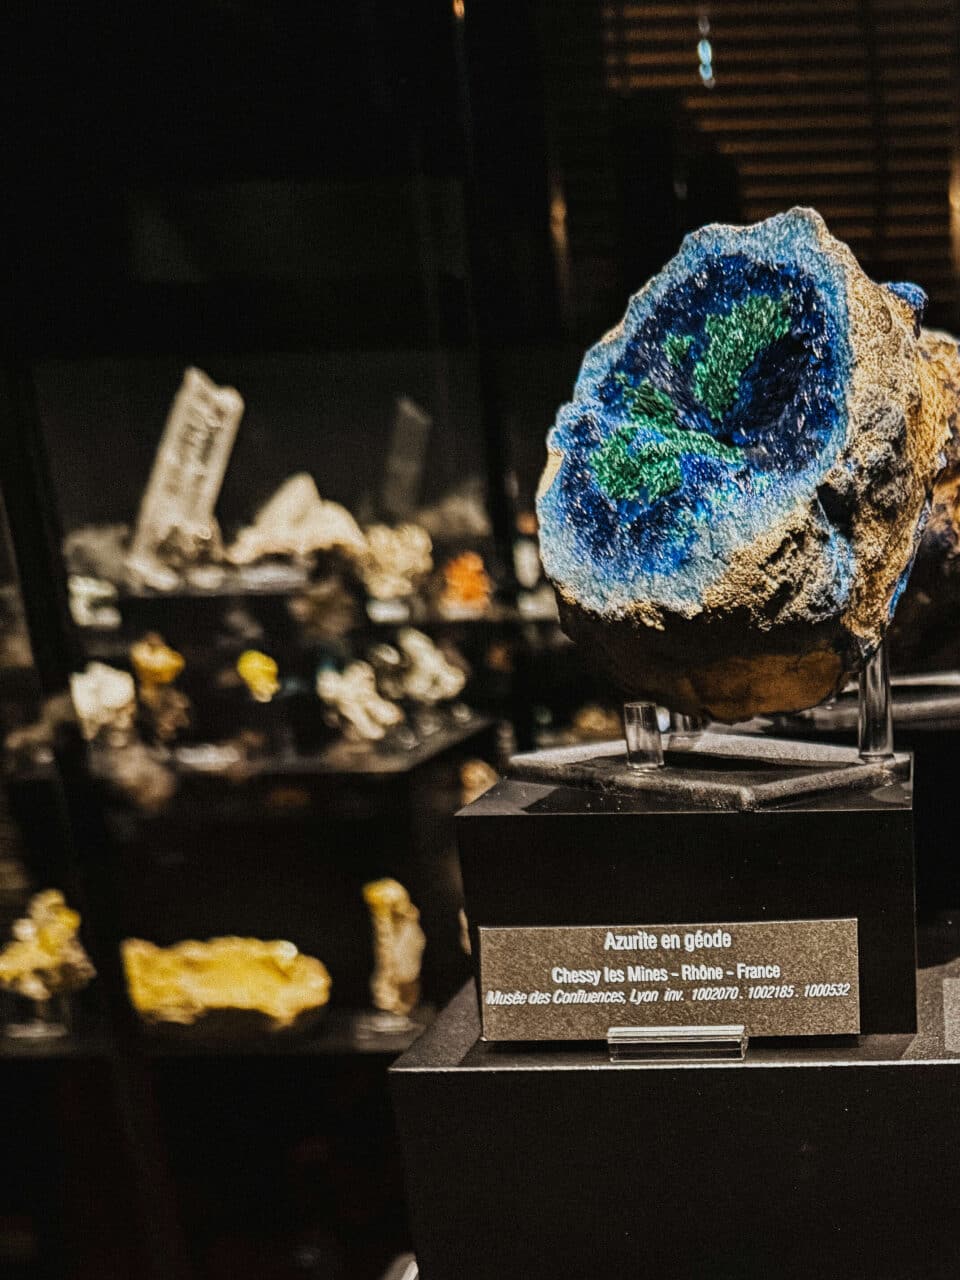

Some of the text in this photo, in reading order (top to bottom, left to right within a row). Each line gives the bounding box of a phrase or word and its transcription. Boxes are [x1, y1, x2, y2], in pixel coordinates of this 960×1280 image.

[604, 930, 731, 953] Azurite en géode
[552, 968, 601, 986] Chessy
[604, 968, 624, 982] les
[627, 966, 668, 982] Mines
[682, 964, 723, 980] Rhône
[737, 963, 780, 979] France
[486, 990, 526, 1006] Musée
[528, 990, 551, 1005] des
[552, 989, 626, 1006] Confluences,
[629, 988, 658, 1004] Lyon
[664, 988, 684, 1001] inv.
[804, 984, 850, 998] 1000532
